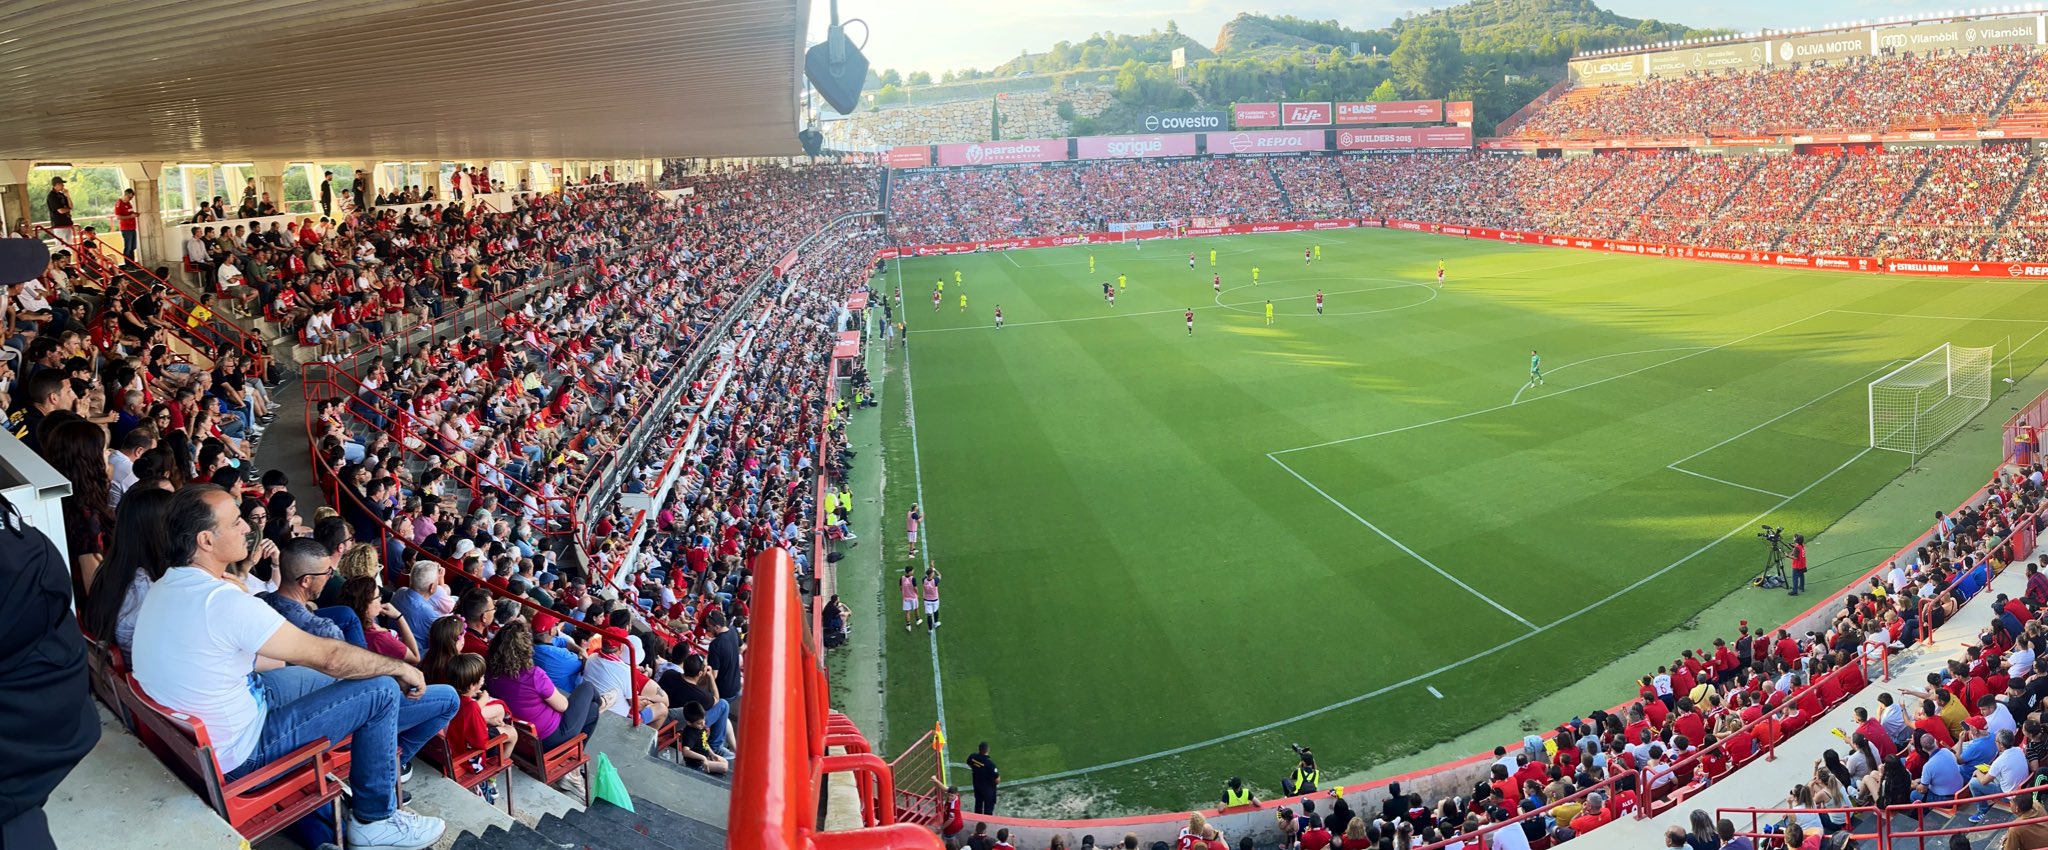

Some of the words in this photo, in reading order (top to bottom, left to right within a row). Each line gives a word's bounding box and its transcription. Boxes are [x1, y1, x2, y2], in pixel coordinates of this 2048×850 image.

[1910, 31, 1959, 46] Vilamòbil
[1980, 26, 2033, 40] Vilamòbil
[1796, 43, 1825, 56] OLIVA
[1826, 39, 1863, 54] MOTOR
[1707, 57, 1743, 65] AUTOLICA
[1593, 61, 1633, 74] LEXUS
[1352, 104, 1377, 114] BASF
[1291, 108, 1322, 123] hife
[1162, 115, 1219, 129] covestro
[1257, 137, 1303, 147] REPSOL
[1354, 134, 1395, 143] BUILDERS
[1396, 134, 1412, 143] 2015
[984, 144, 1041, 156] paradox
[1705, 251, 1731, 260] PLANNING
[1897, 263, 1927, 272] ESTRELLA
[1927, 264, 1949, 273] DAMM
[1706, 665, 1714, 678] 7
[1660, 682, 1668, 694] 6
[1622, 799, 1634, 808] ALEX
